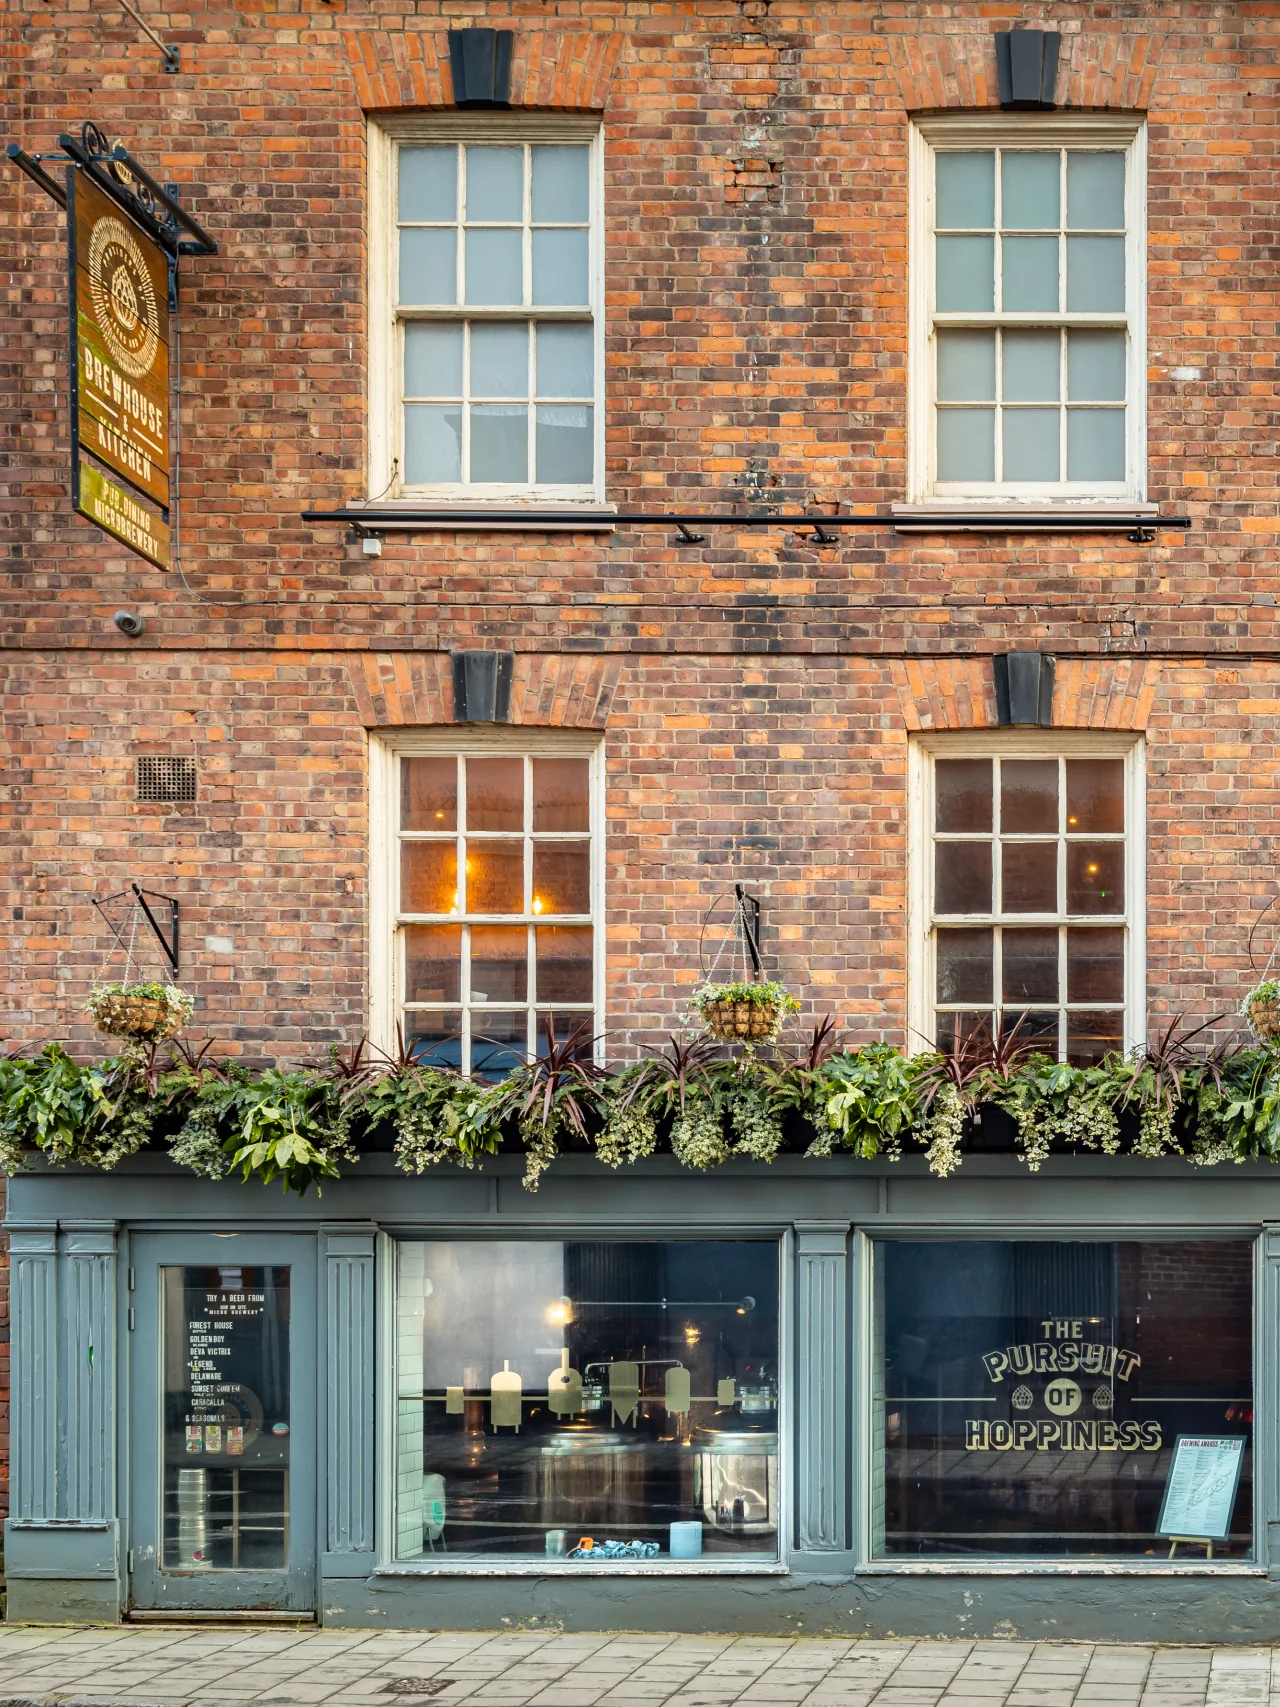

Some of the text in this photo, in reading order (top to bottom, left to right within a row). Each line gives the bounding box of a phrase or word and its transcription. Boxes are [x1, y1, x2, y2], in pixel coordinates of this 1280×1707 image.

[84, 347, 163, 440] BREWHOUSE
[123, 415, 129, 432] &
[98, 415, 152, 482] KITCHEN
[94, 498, 158, 558] MICROBREWERY
[206, 1294, 265, 1302] TRY A BEER FROM
[189, 1321, 233, 1329] FOREST HOUSE
[1041, 1321, 1083, 1339] THE
[190, 1335, 225, 1343] GOLDEN BOY
[190, 1360, 213, 1368] LEGEND
[982, 1342, 1141, 1383] PURSUIT
[190, 1372, 222, 1380] DELAWARE
[1048, 1387, 1078, 1406] OF
[965, 1420, 1163, 1451] HOPPINESS
